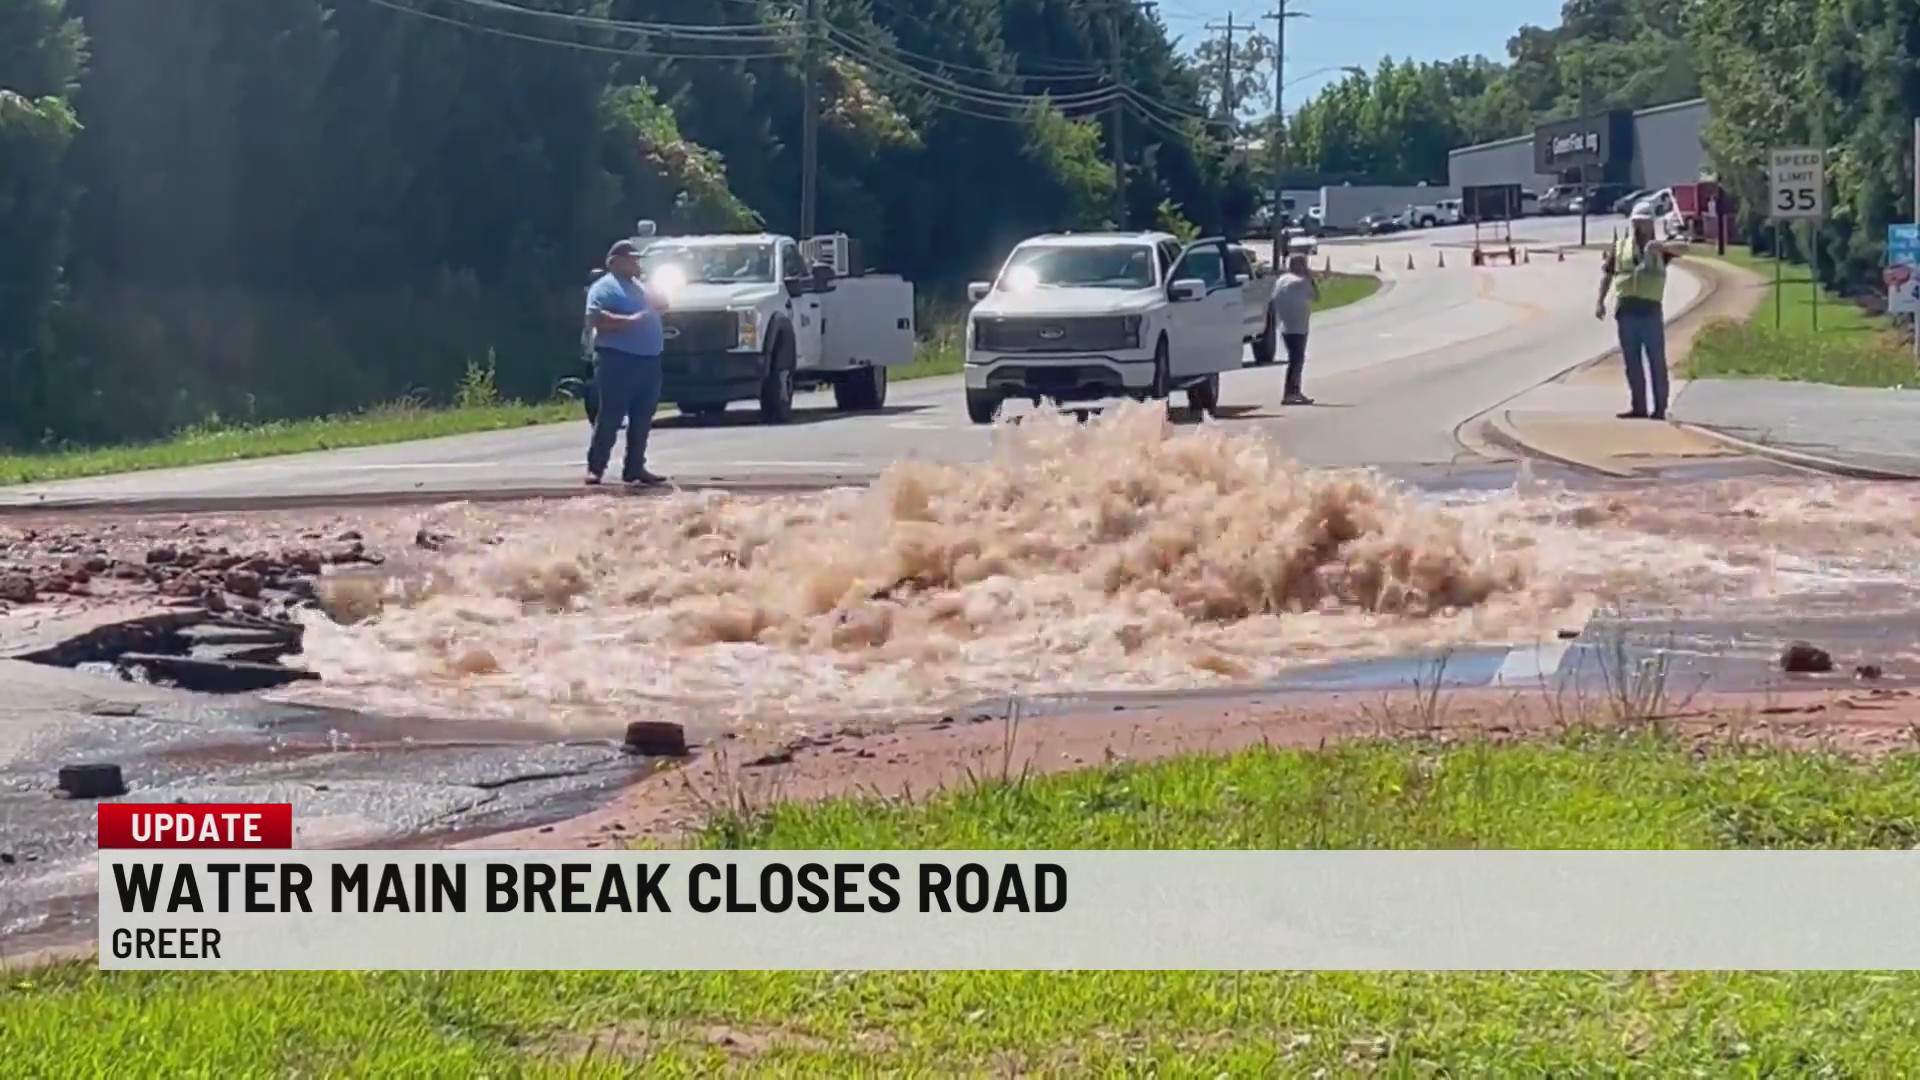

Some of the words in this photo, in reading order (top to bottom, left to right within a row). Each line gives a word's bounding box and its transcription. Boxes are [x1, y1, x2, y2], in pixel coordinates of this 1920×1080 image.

[1774, 154, 1820, 166] SPEED
[1778, 171, 1815, 183] LIMIT
[1777, 188, 1817, 211] 35
